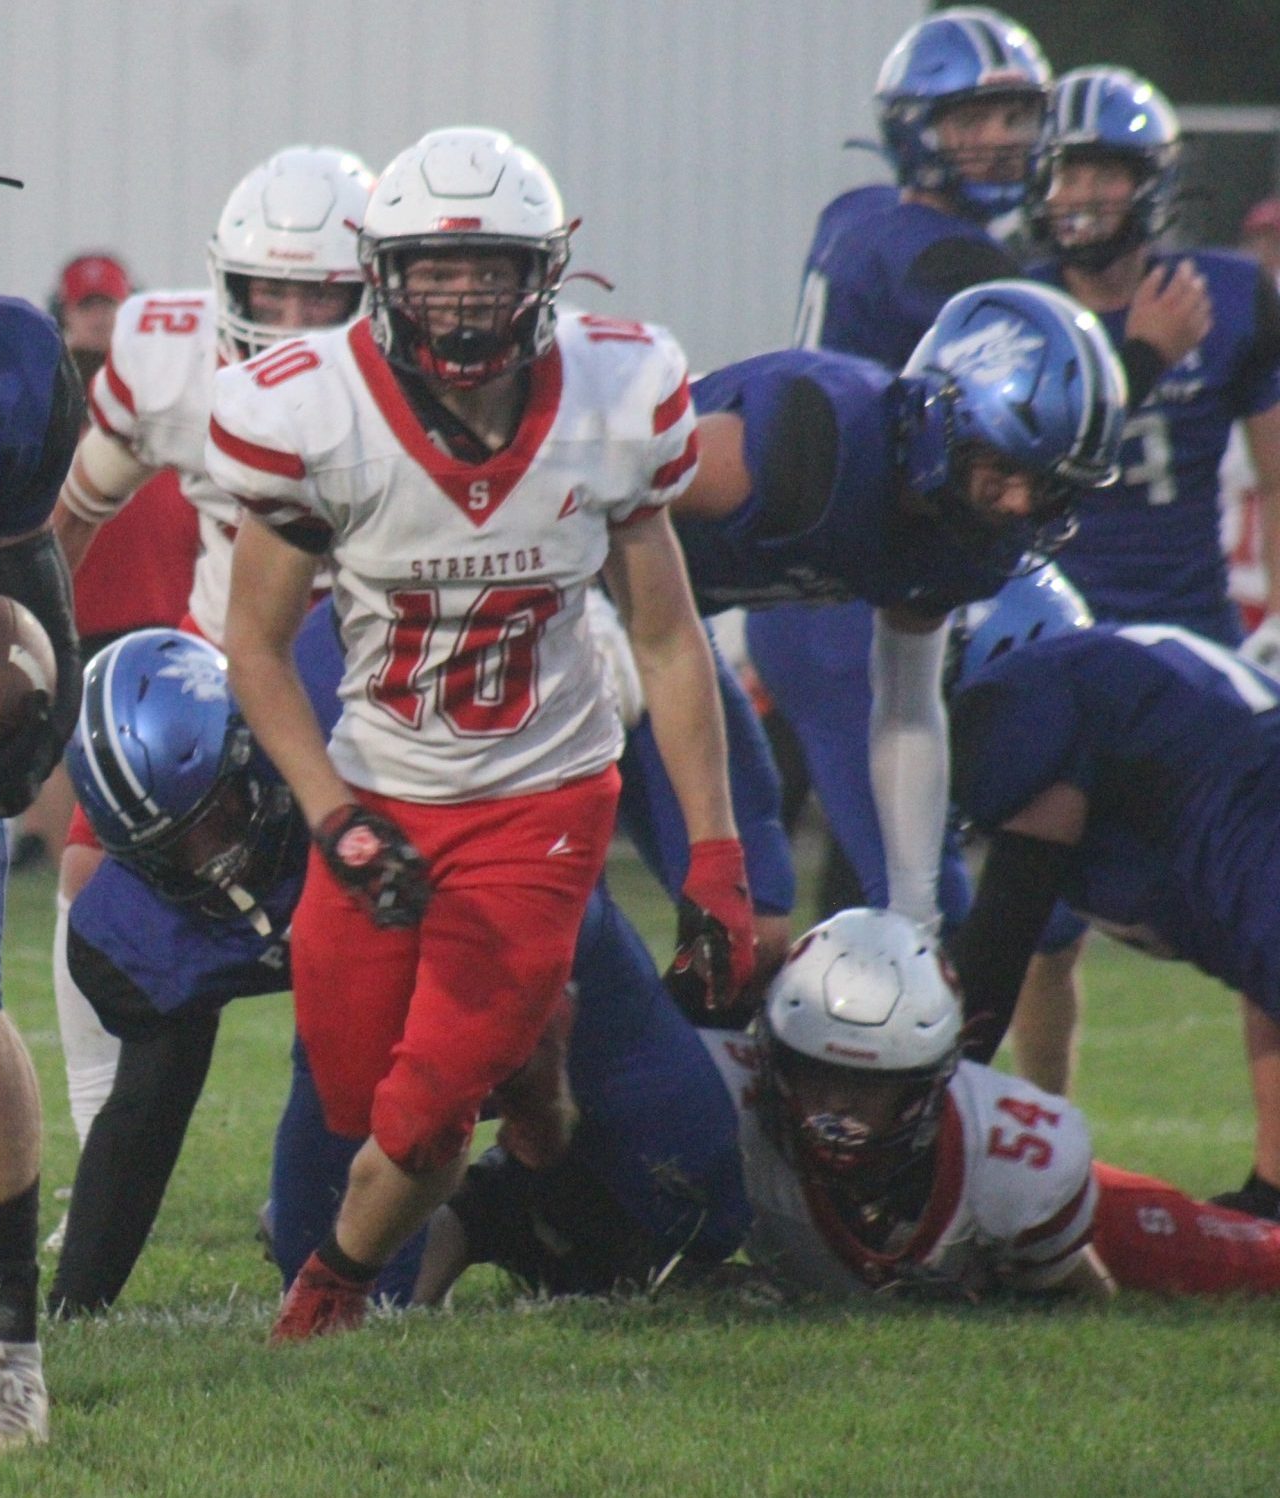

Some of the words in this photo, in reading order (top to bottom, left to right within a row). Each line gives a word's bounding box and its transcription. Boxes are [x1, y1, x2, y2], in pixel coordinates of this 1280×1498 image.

[137, 298, 205, 335] 12
[244, 340, 322, 389] 10
[468, 479, 490, 511] S
[410, 546, 546, 581] STREATOR
[366, 579, 565, 740] 10
[986, 1096, 1061, 1172] 54
